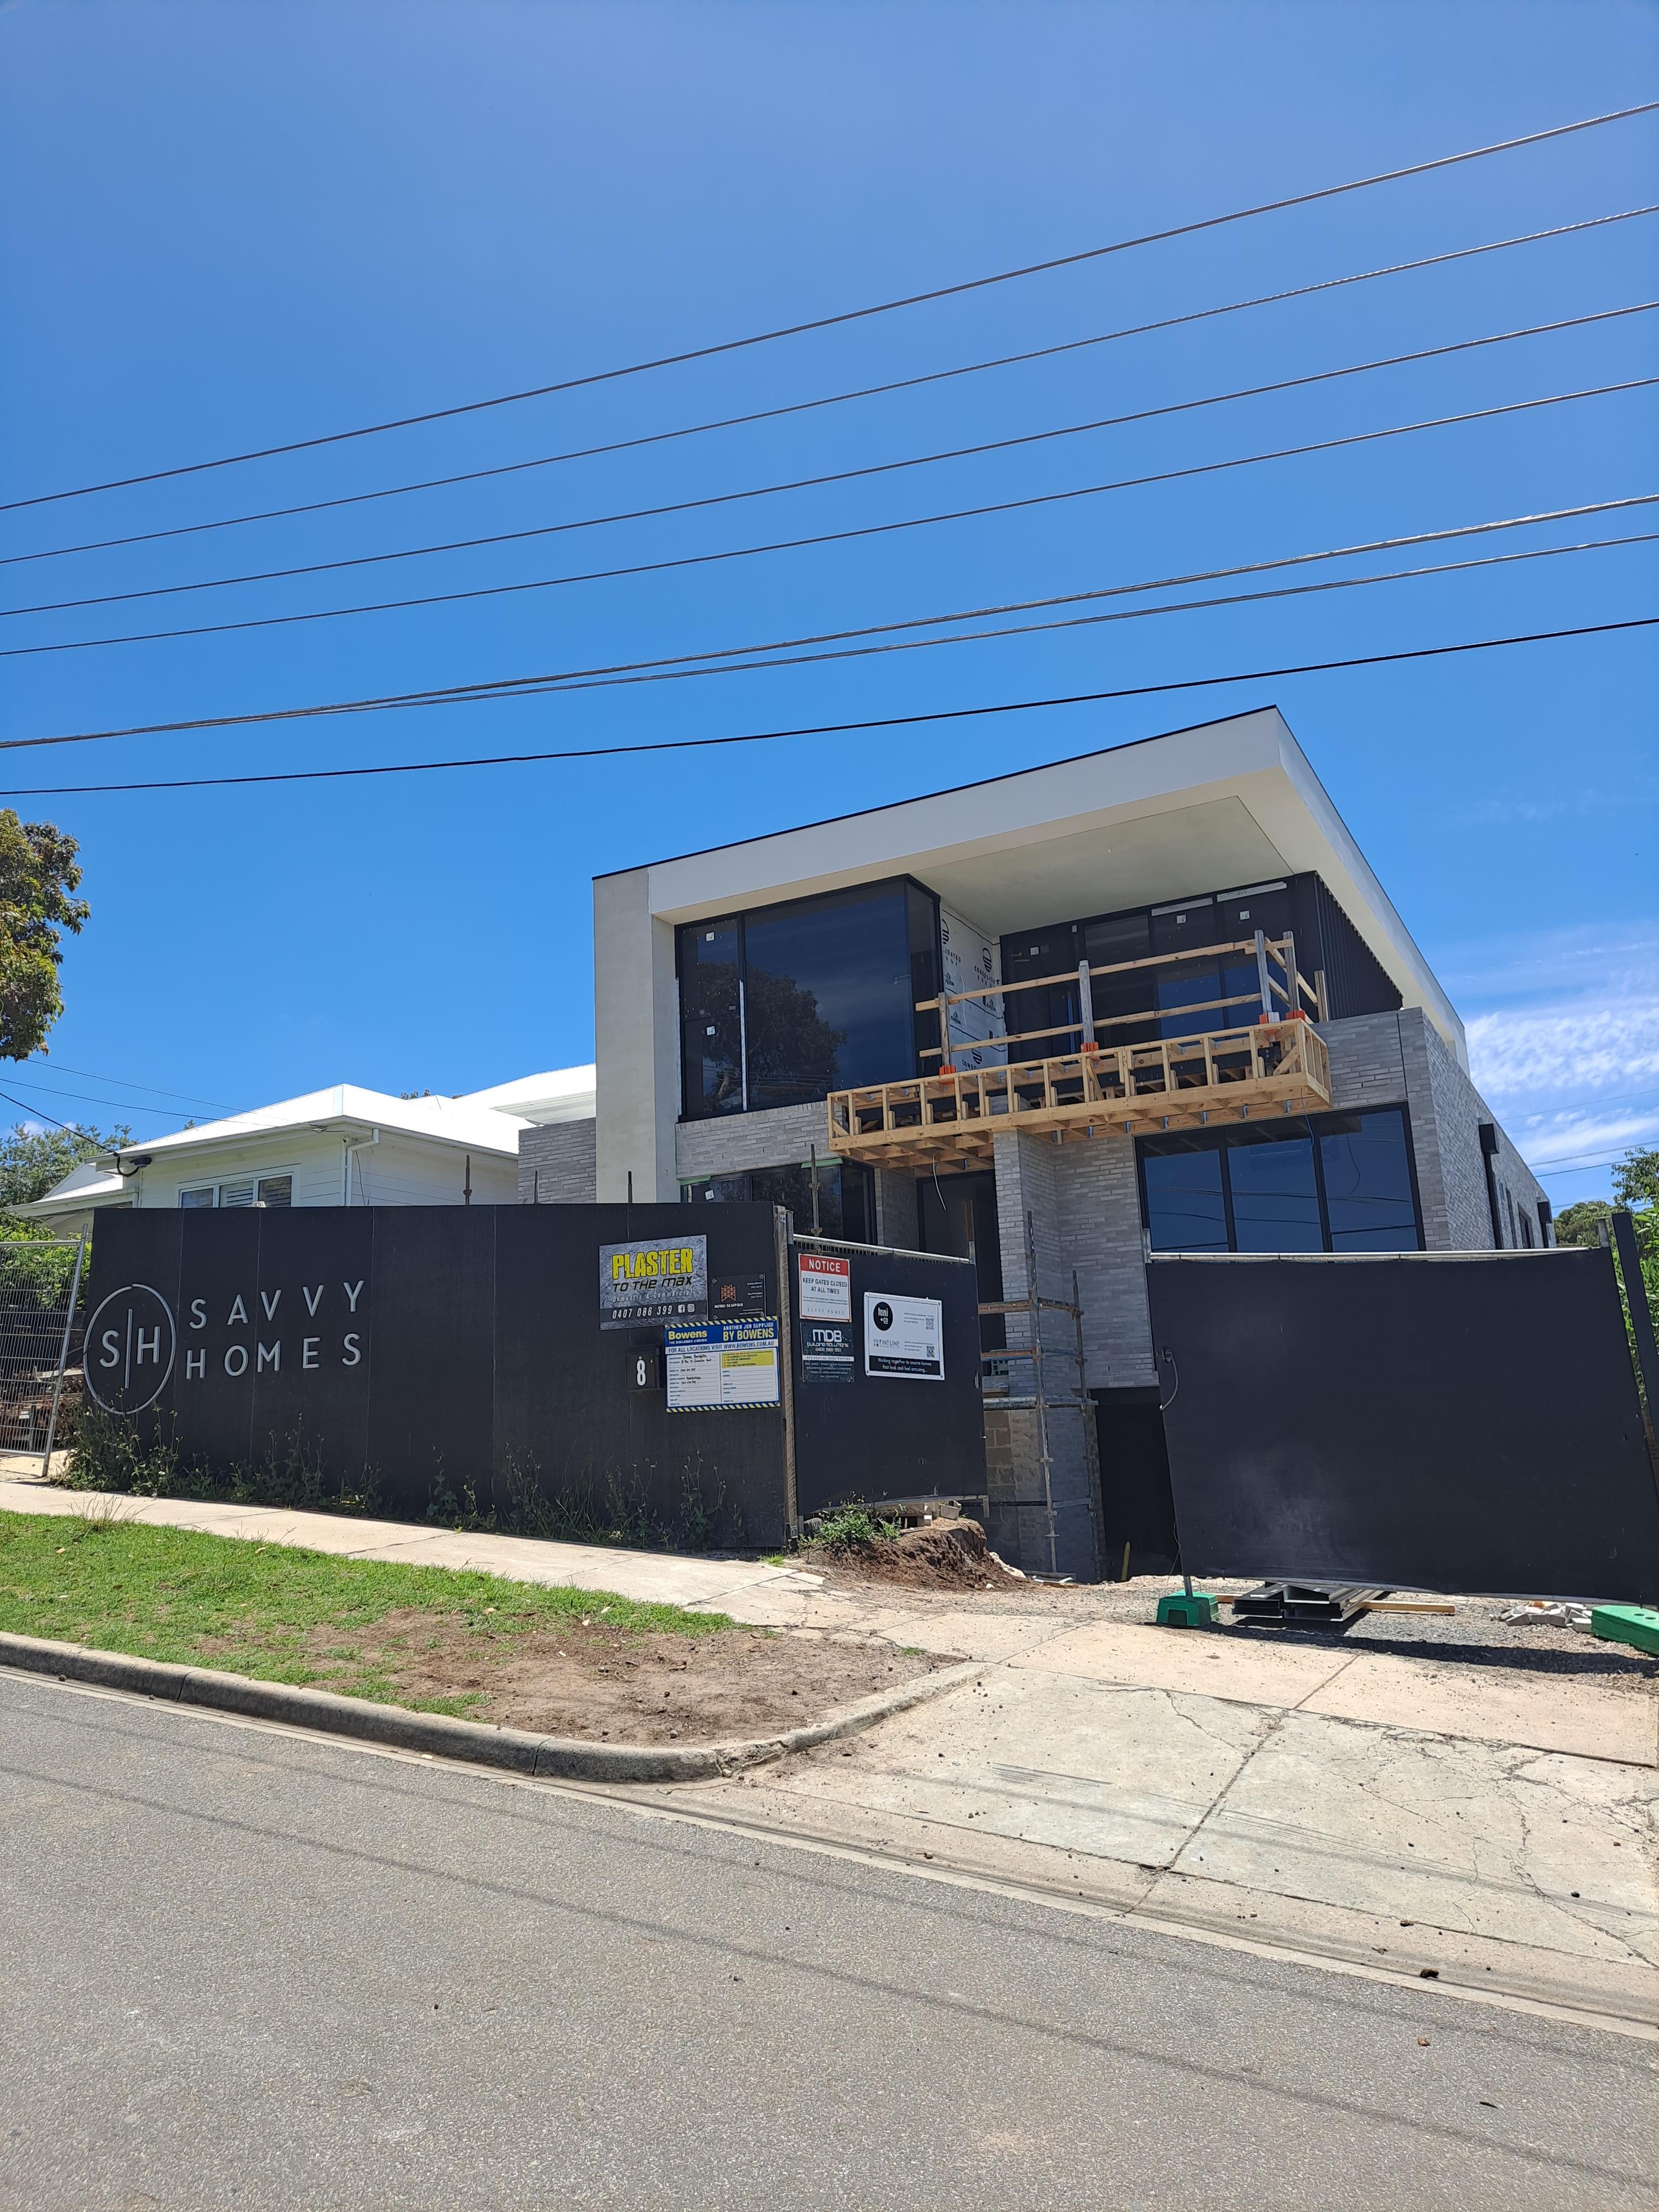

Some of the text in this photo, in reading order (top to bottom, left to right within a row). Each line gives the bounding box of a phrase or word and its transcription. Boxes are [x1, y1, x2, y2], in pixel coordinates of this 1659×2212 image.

[612, 1248, 693, 1280] PLASTER
[808, 1259, 841, 1272] NOTICE
[613, 1283, 629, 1292] TO
[189, 1280, 365, 1329] SAVVY
[612, 1305, 672, 1319] 0407 086 399
[878, 1307, 888, 1317] toni
[668, 1330, 708, 1340] Bowens
[723, 1328, 774, 1341] BY BOWENS
[723, 1340, 774, 1349] WWW.BOWENS.COM.AU
[186, 1333, 362, 1380] HOMES
[637, 1360, 646, 1386] 8
